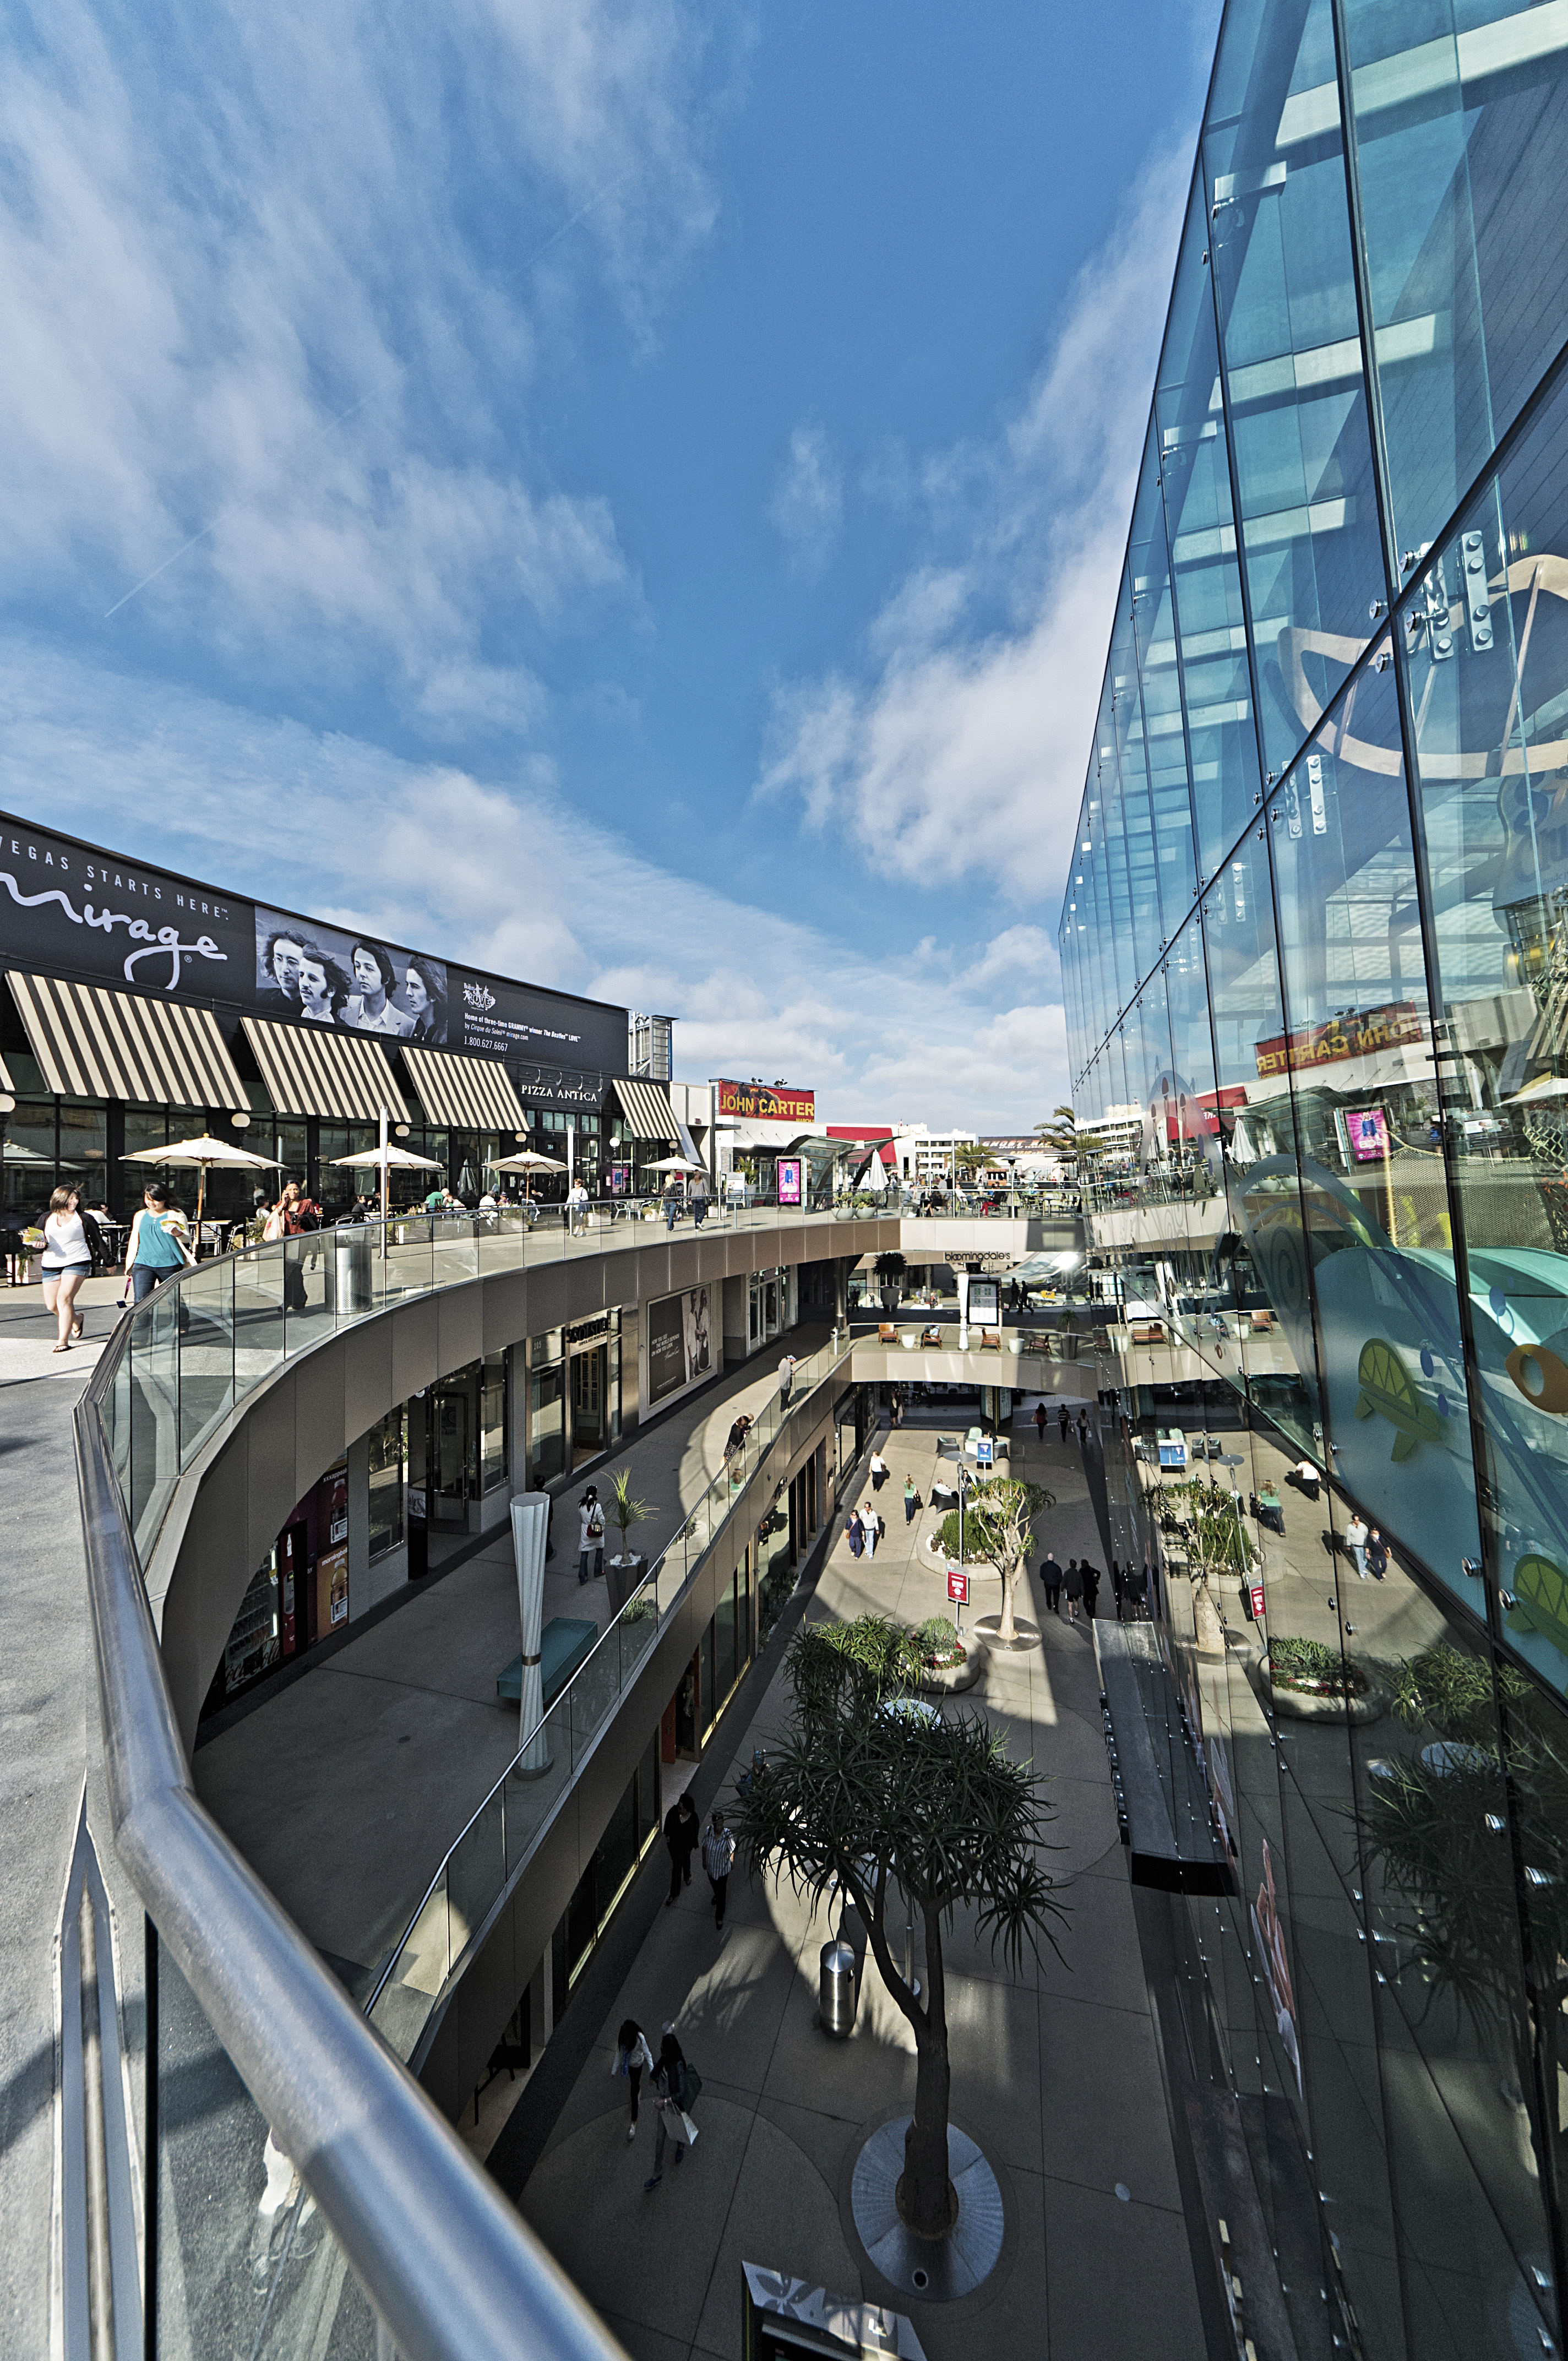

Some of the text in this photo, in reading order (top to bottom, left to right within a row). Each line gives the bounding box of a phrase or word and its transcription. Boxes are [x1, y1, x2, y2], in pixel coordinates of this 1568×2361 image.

[86, 865, 161, 899] STARTS
[465, 1013, 478, 1021] Home
[484, 1017, 507, 1028] three-time
[529, 1027, 542, 1035] winner
[471, 1024, 484, 1032] Cirque
[506, 1032, 529, 1041] mirage.com
[464, 1036, 508, 1052] 1.800.627.6667
[521, 1085, 597, 1102] PIZZA ANTICA
[722, 1095, 814, 1117] JOHN CARTER
[945, 1251, 1011, 1262] bloomingdale's
